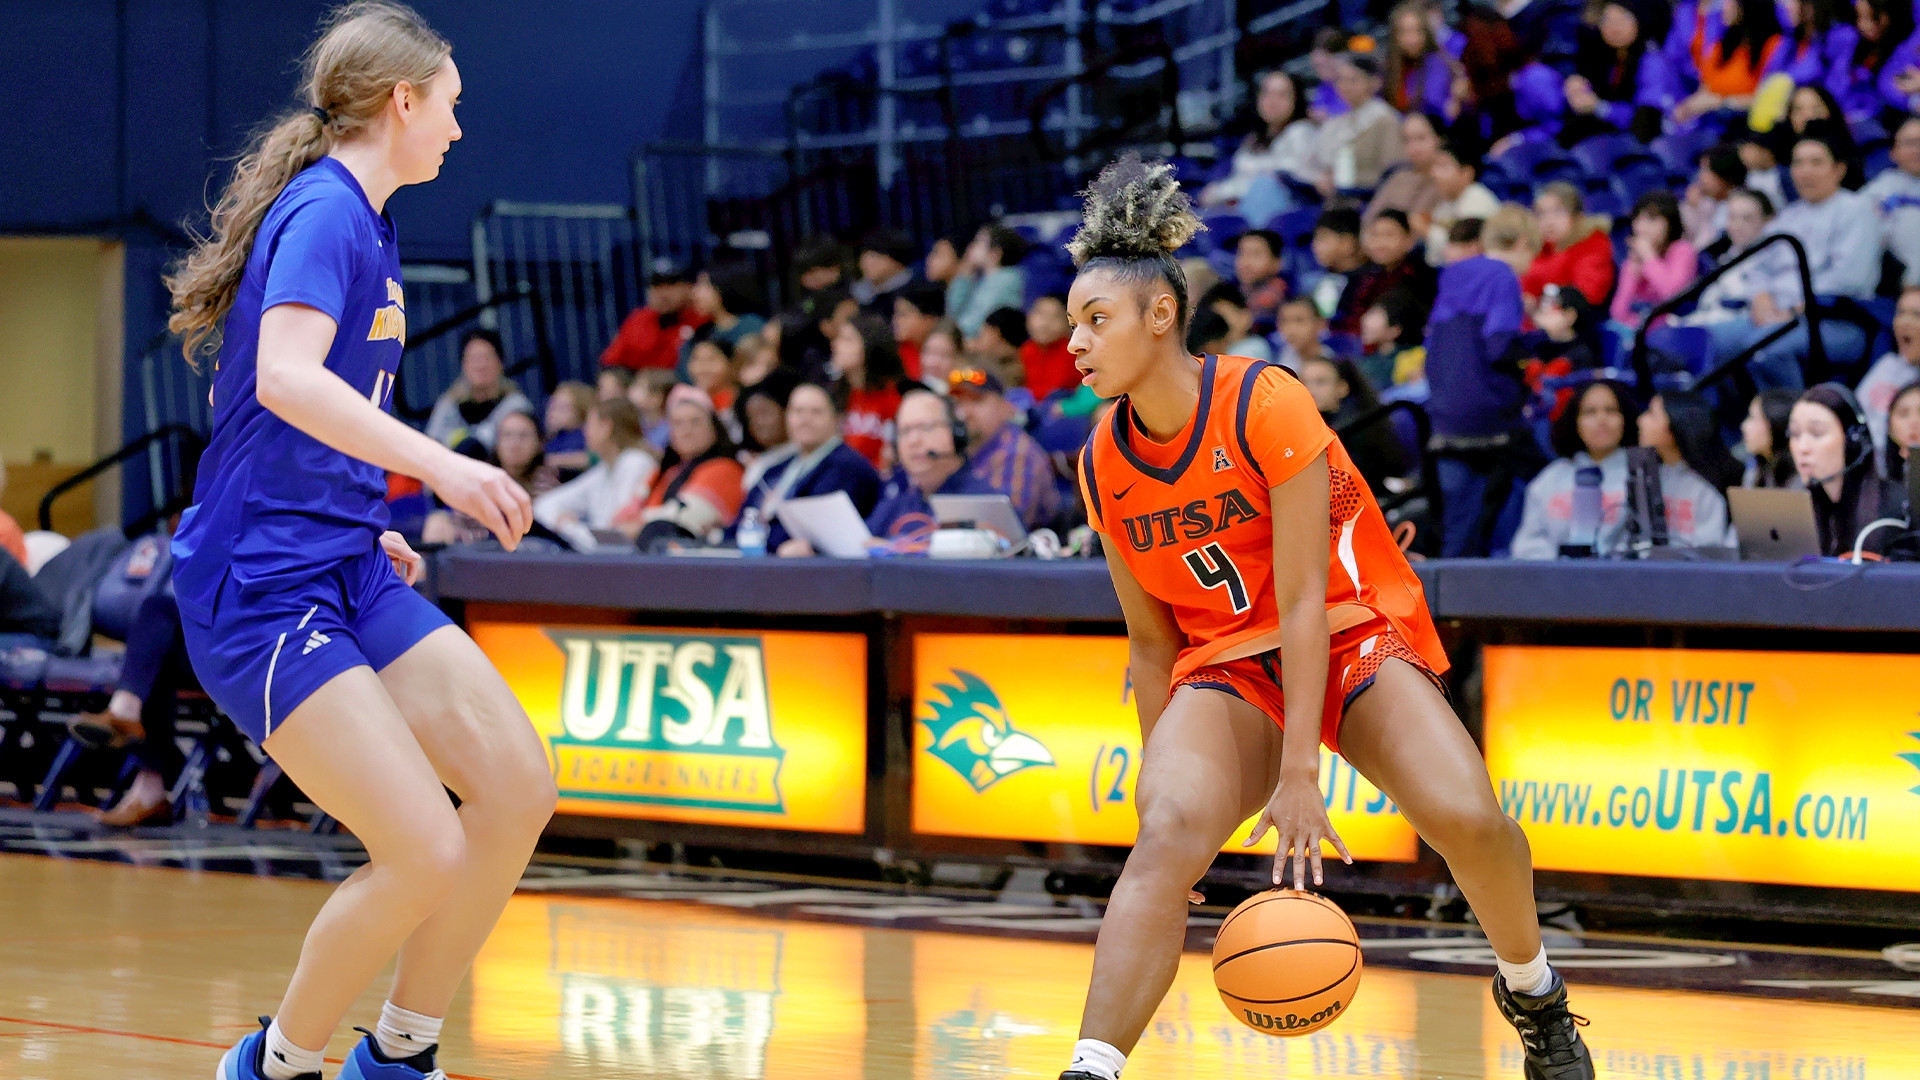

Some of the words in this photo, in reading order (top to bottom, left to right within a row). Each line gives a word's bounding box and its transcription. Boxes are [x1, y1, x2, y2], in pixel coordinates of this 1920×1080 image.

[1122, 488, 1260, 552] UTSA
[1181, 541, 1251, 615] 4
[565, 638, 773, 748] UTSA
[1611, 678, 1653, 722] OR
[1672, 680, 1755, 725] VISIT
[1244, 1000, 1342, 1030] Wilson
